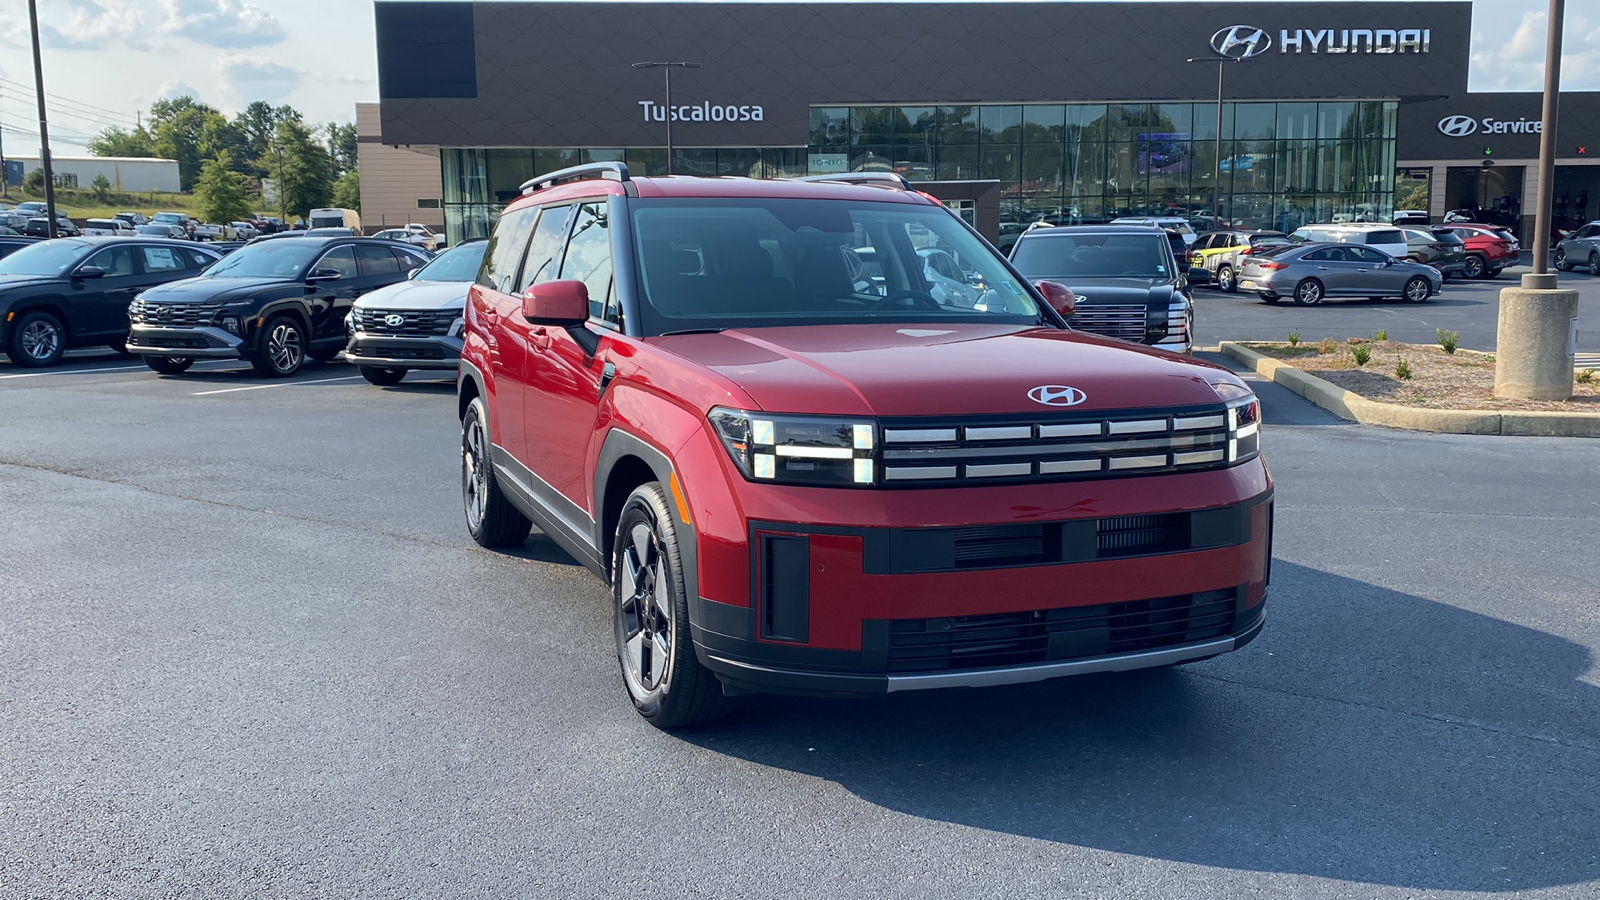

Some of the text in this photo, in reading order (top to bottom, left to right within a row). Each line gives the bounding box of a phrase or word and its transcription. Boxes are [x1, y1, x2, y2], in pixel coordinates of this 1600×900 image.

[1279, 28, 1431, 54] HYUNDAI
[638, 100, 764, 122] Tuscaloosa
[1481, 117, 1543, 134] Service
